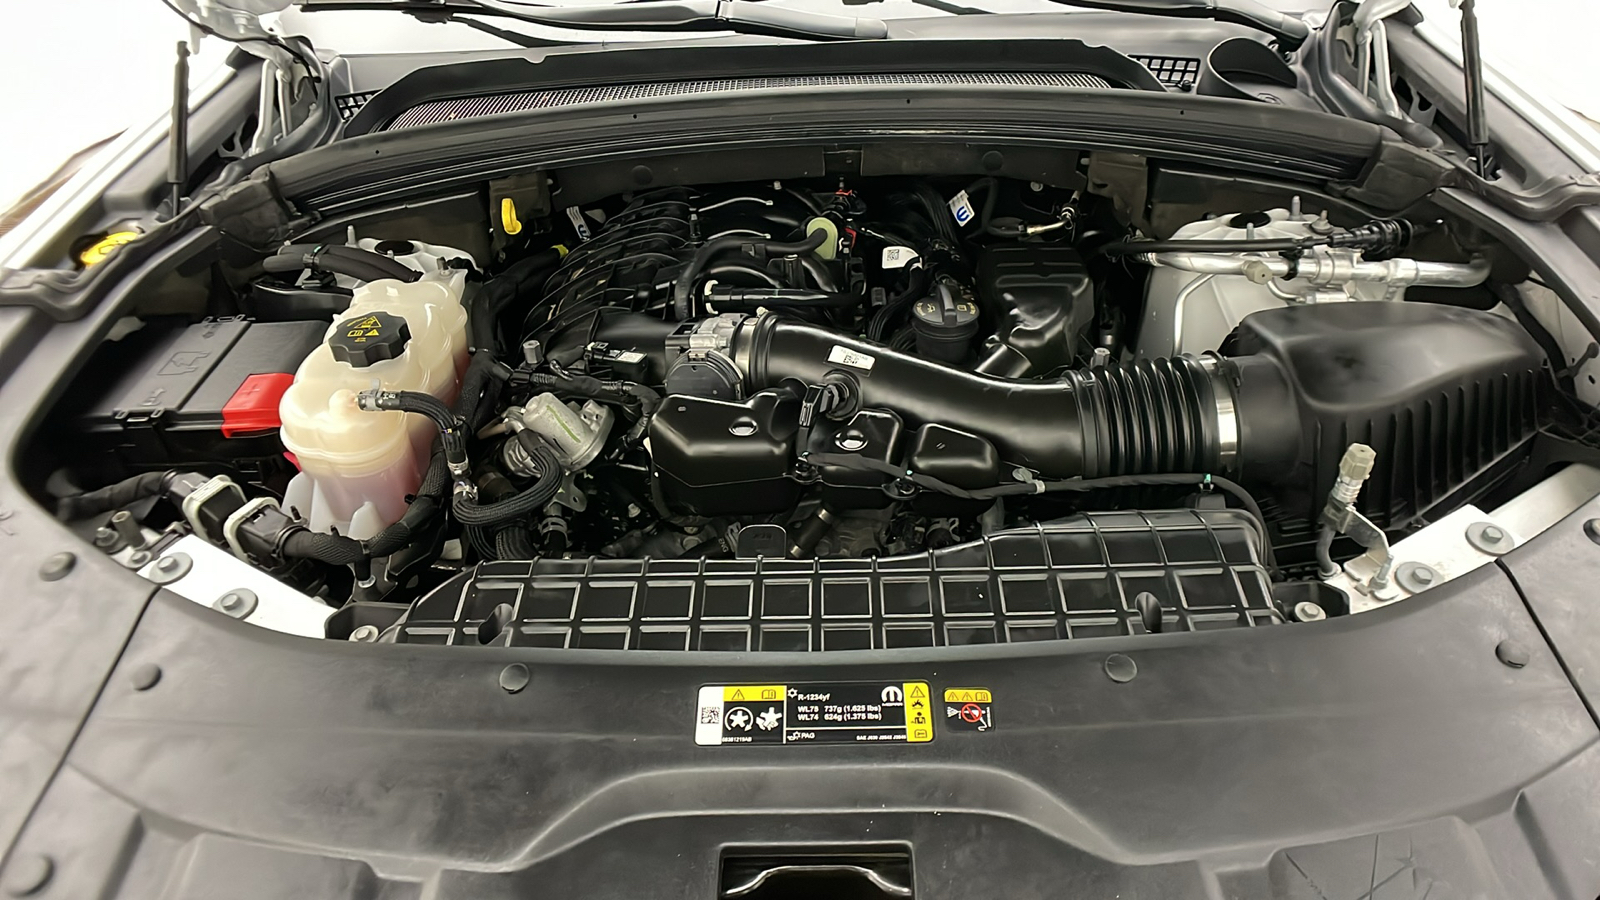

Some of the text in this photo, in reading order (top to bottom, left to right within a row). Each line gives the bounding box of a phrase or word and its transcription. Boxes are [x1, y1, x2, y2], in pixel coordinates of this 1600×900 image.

[797, 694, 830, 702] R-1234yf
[824, 705, 842, 713] 737g
[843, 705, 866, 713] (1.625
[867, 705, 882, 713] lbs)
[824, 714, 842, 722] 624g
[843, 713, 866, 721] (1.375
[867, 713, 882, 721] lbs)
